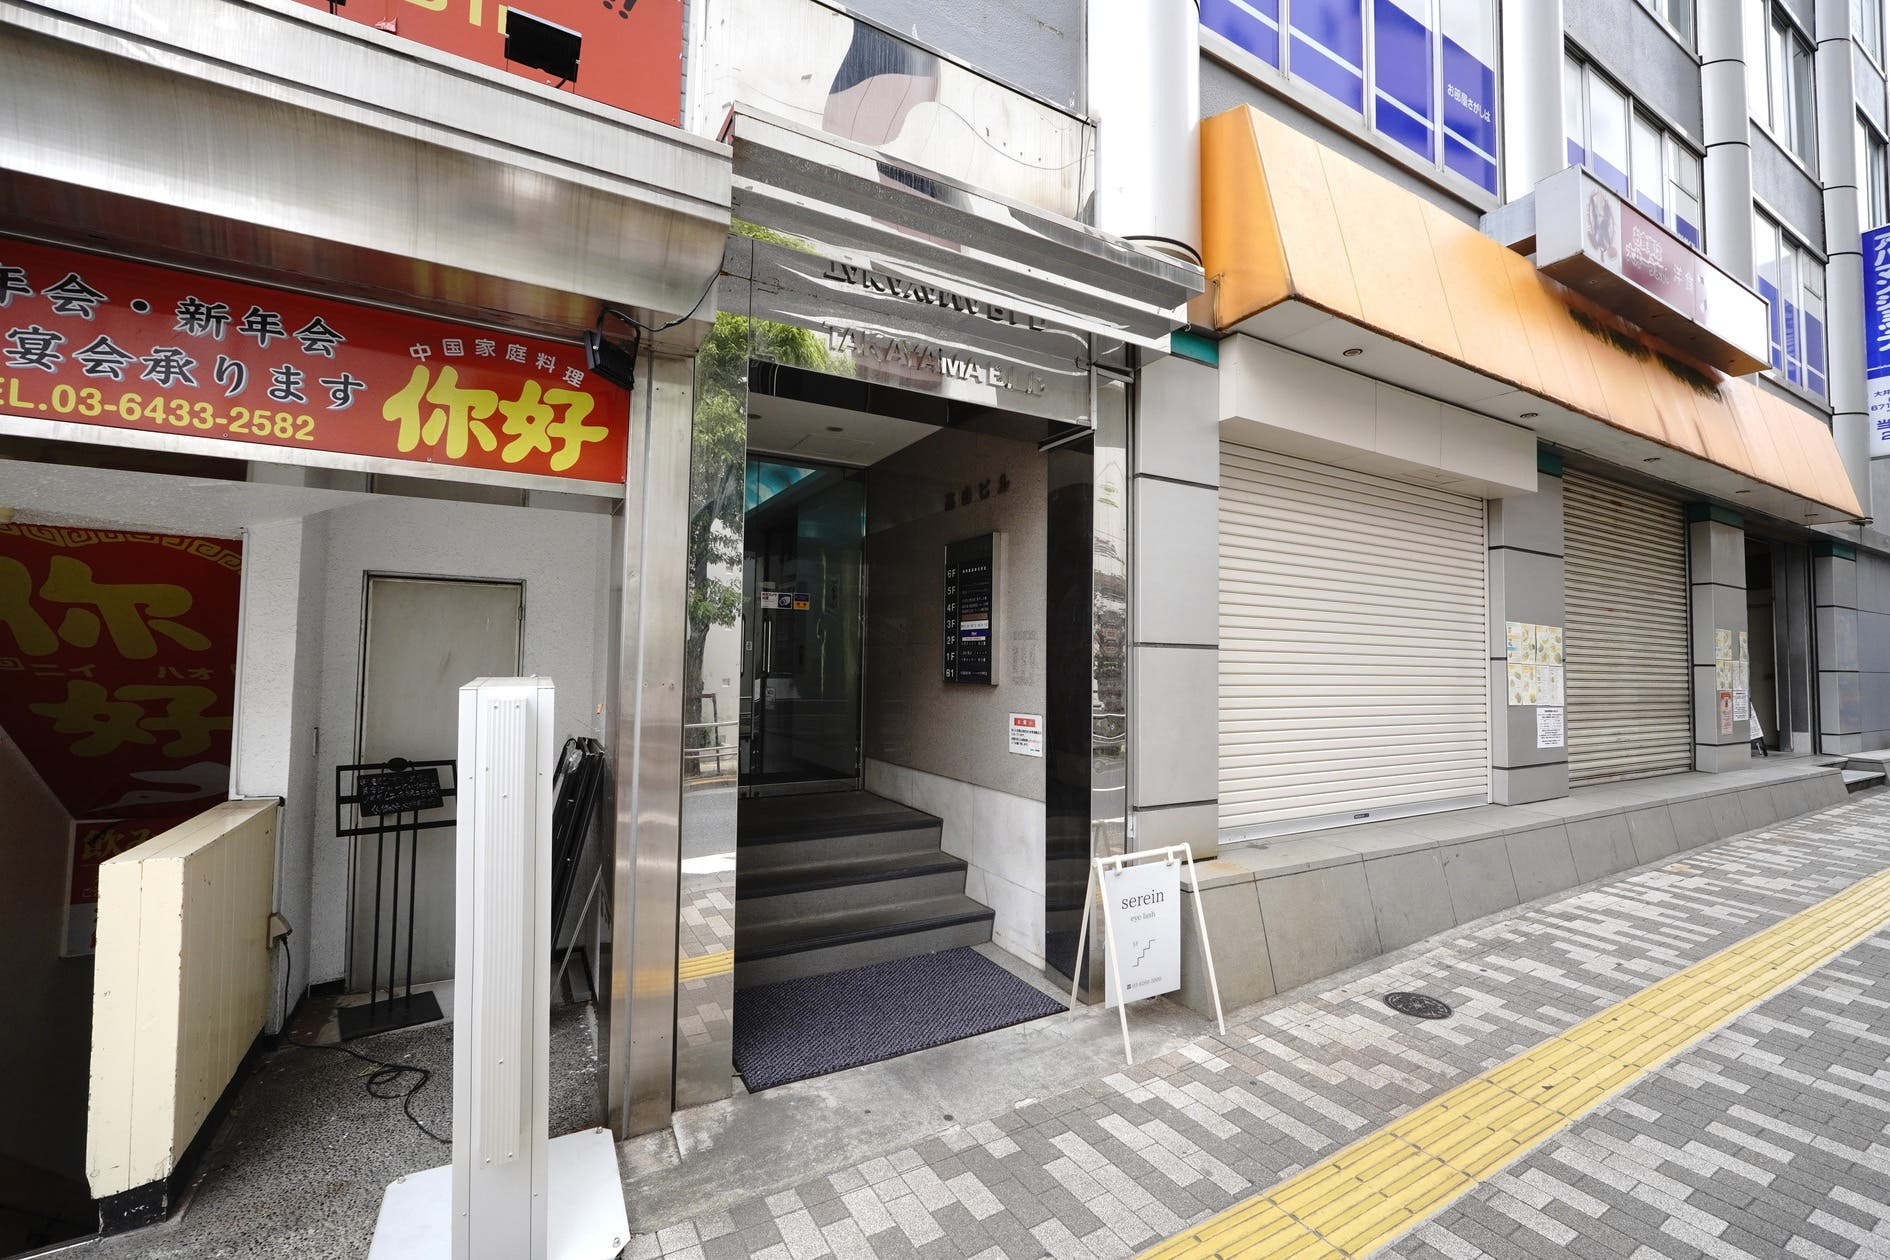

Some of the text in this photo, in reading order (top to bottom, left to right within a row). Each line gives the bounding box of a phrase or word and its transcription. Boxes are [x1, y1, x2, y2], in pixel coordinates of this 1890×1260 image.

[1447, 83, 1491, 122] お部屋さがしは
[5, 325, 367, 409] 宴会承ります
[410, 338, 585, 388] 中国家庭料理
[0, 377, 314, 441] L.03-6433-2582
[382, 365, 609, 471] 你好
[946, 603, 955, 611] 4F
[946, 620, 955, 628] 3F
[946, 652, 955, 660] 1F
[1121, 889, 1164, 910] serein
